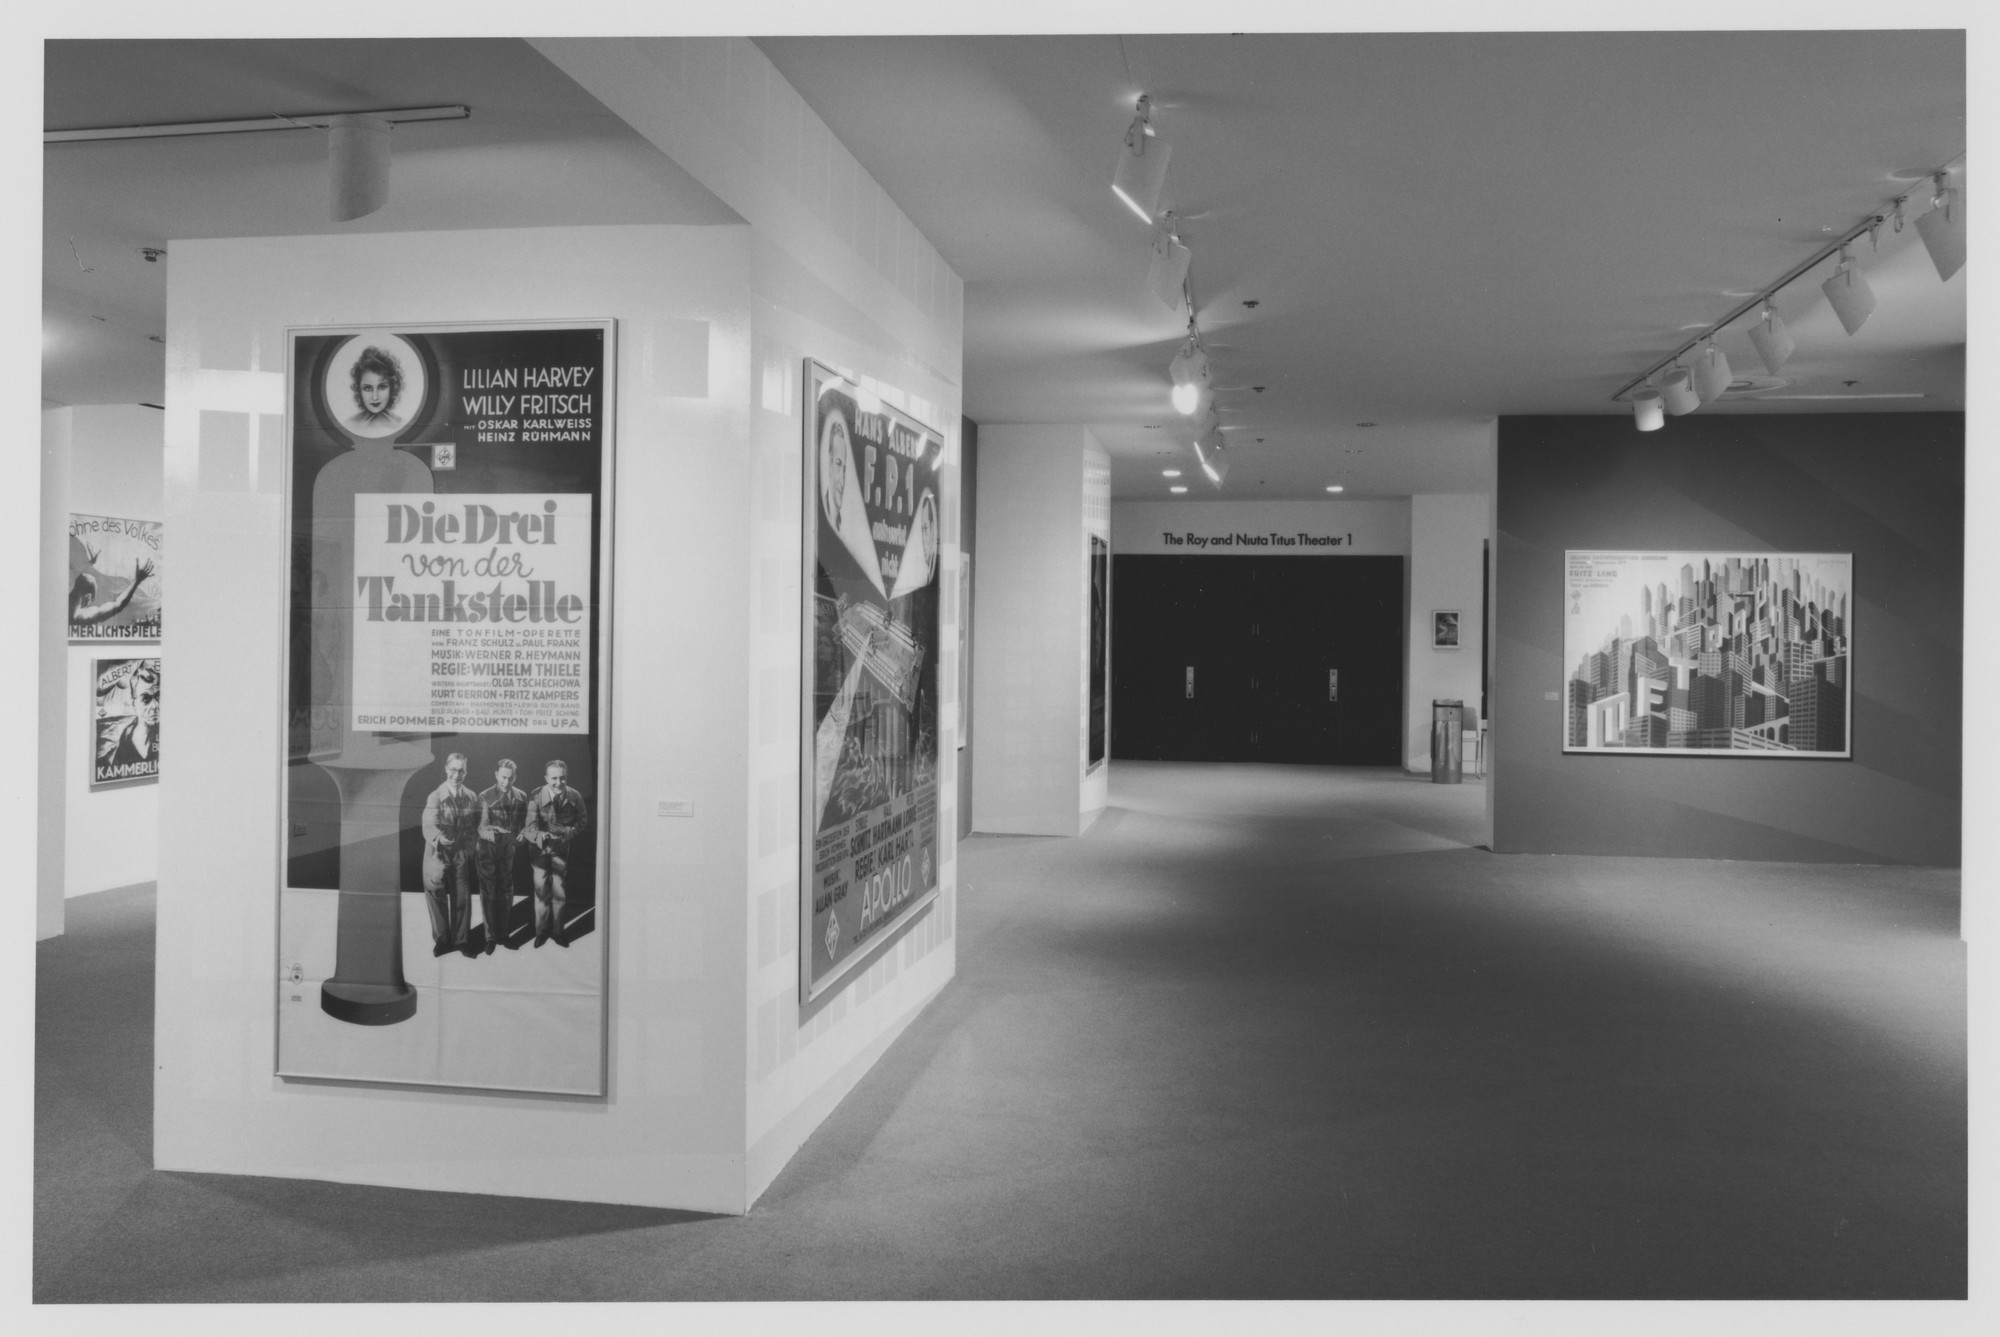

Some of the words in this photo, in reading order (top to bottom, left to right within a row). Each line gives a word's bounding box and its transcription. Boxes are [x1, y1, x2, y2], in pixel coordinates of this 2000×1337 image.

[463, 368, 518, 389] LILIAN
[523, 366, 595, 388] HARVEY
[462, 395, 516, 416] WILLY
[520, 394, 592, 415] FRITSCH
[477, 419, 519, 430] OSKAR
[854, 407, 883, 444] HANS
[477, 432, 515, 442] HEINZ
[522, 430, 591, 442] RÜHMANN
[384, 500, 460, 544] Die
[461, 499, 558, 545] Drei
[102, 518, 121, 533] des
[124, 520, 159, 550] Volkes
[1163, 532, 1184, 545] The
[1186, 533, 1208, 548] Roy
[1210, 533, 1233, 546] and
[1236, 533, 1268, 546] Niuta
[1270, 533, 1296, 546] Titus
[1297, 533, 1343, 546] Theater
[1347, 533, 1352, 546] 1
[401, 553, 470, 577] von
[474, 546, 534, 578] der
[357, 576, 584, 624] Tankstelle
[431, 629, 450, 637] EINE
[446, 638, 478, 647] FRANZ
[480, 638, 514, 647] SCHULZ
[522, 639, 545, 648] PAUL
[547, 639, 580, 648] FRANK
[465, 650, 511, 660] WERNER
[102, 664, 132, 689] ALBERT
[431, 662, 470, 676] REGIE:
[471, 662, 532, 676] WILHELM
[535, 663, 581, 677] THIELE
[491, 678, 514, 687] OLGA
[516, 678, 581, 688] TSCHECHOWA
[431, 689, 456, 699] KURT
[457, 690, 497, 699] GERRON
[503, 690, 530, 700] FRITZ
[532, 690, 579, 700] KAMPERS
[357, 715, 387, 725] ERICH
[550, 719, 580, 728] UFA
[97, 760, 159, 780] KAMMERLI
[834, 880, 848, 903] GRAY
[860, 854, 911, 931] APOLLO
